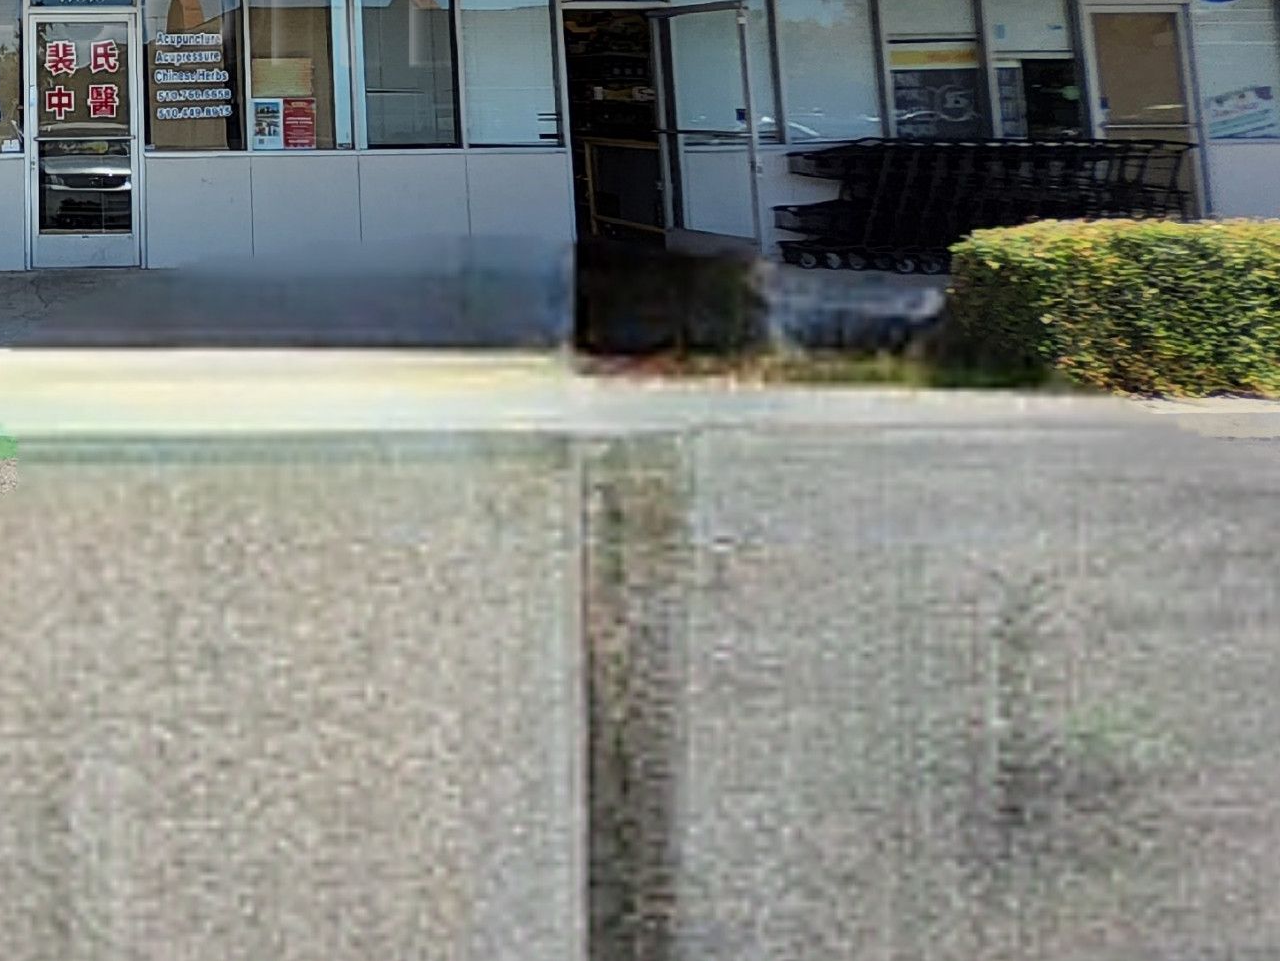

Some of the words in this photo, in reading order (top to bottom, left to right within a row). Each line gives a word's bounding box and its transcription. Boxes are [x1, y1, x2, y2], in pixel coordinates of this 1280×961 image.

[156, 32, 222, 48] Acupuncture
[45, 40, 119, 76] 裴氏
[155, 51, 221, 66] Acupressure
[154, 69, 195, 83] Chinese
[197, 69, 229, 82] Herbs
[46, 84, 119, 120] 中醫
